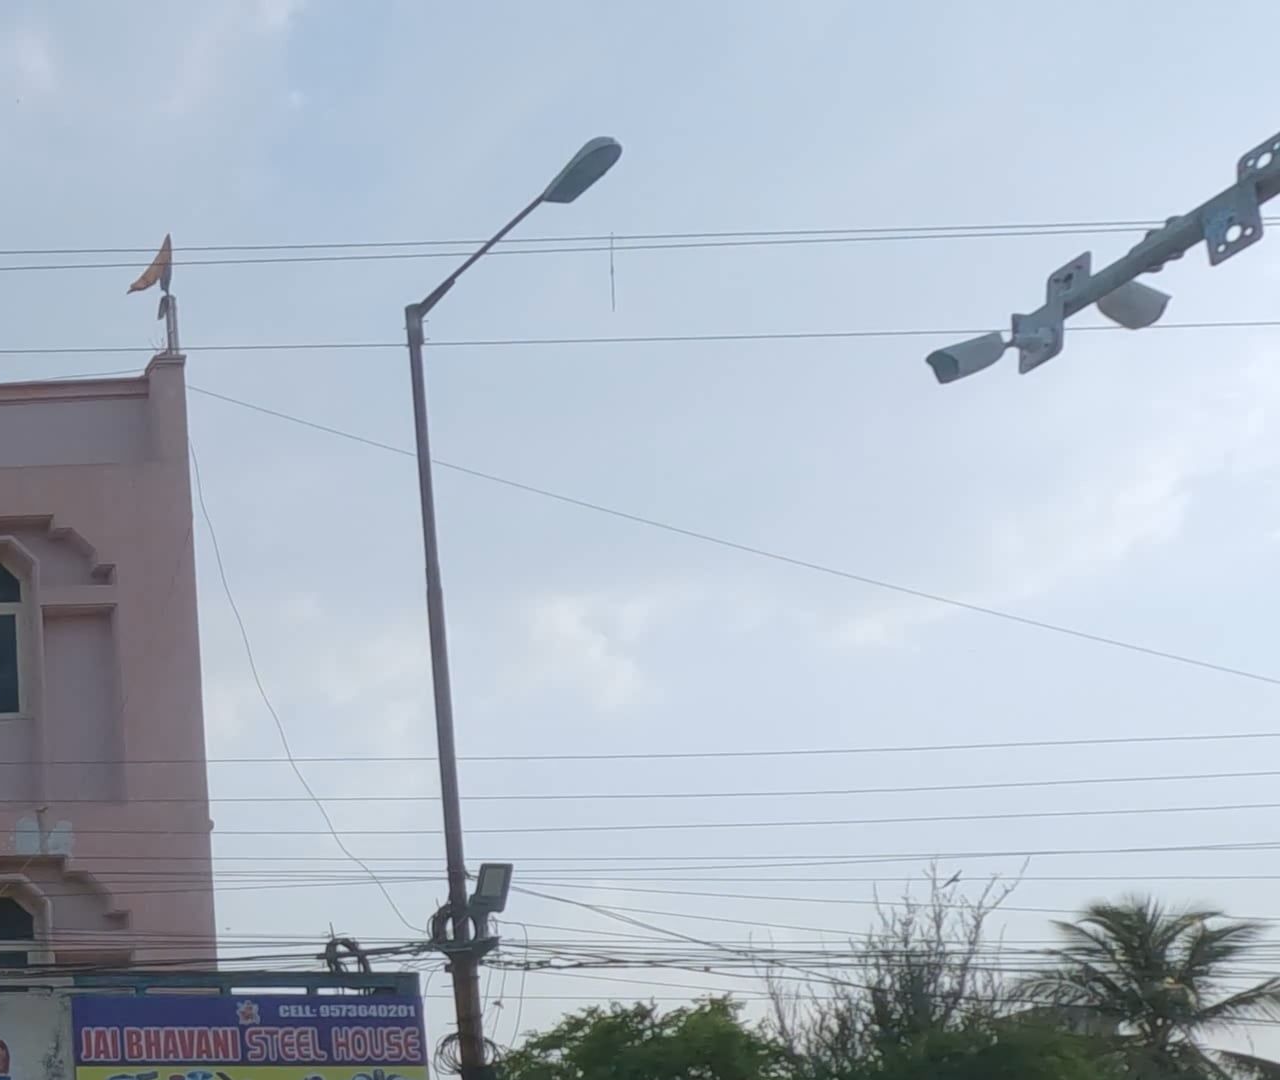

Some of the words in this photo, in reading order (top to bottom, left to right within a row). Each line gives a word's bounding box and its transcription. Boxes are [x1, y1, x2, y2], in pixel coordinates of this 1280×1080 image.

[278, 1004, 317, 1018] CELL:
[319, 1004, 416, 1018] 9573640201
[81, 1026, 119, 1061] JAI
[124, 1026, 240, 1061] BHAVANI
[244, 1026, 327, 1061] STEEL
[332, 1026, 422, 1060] HOUSE
